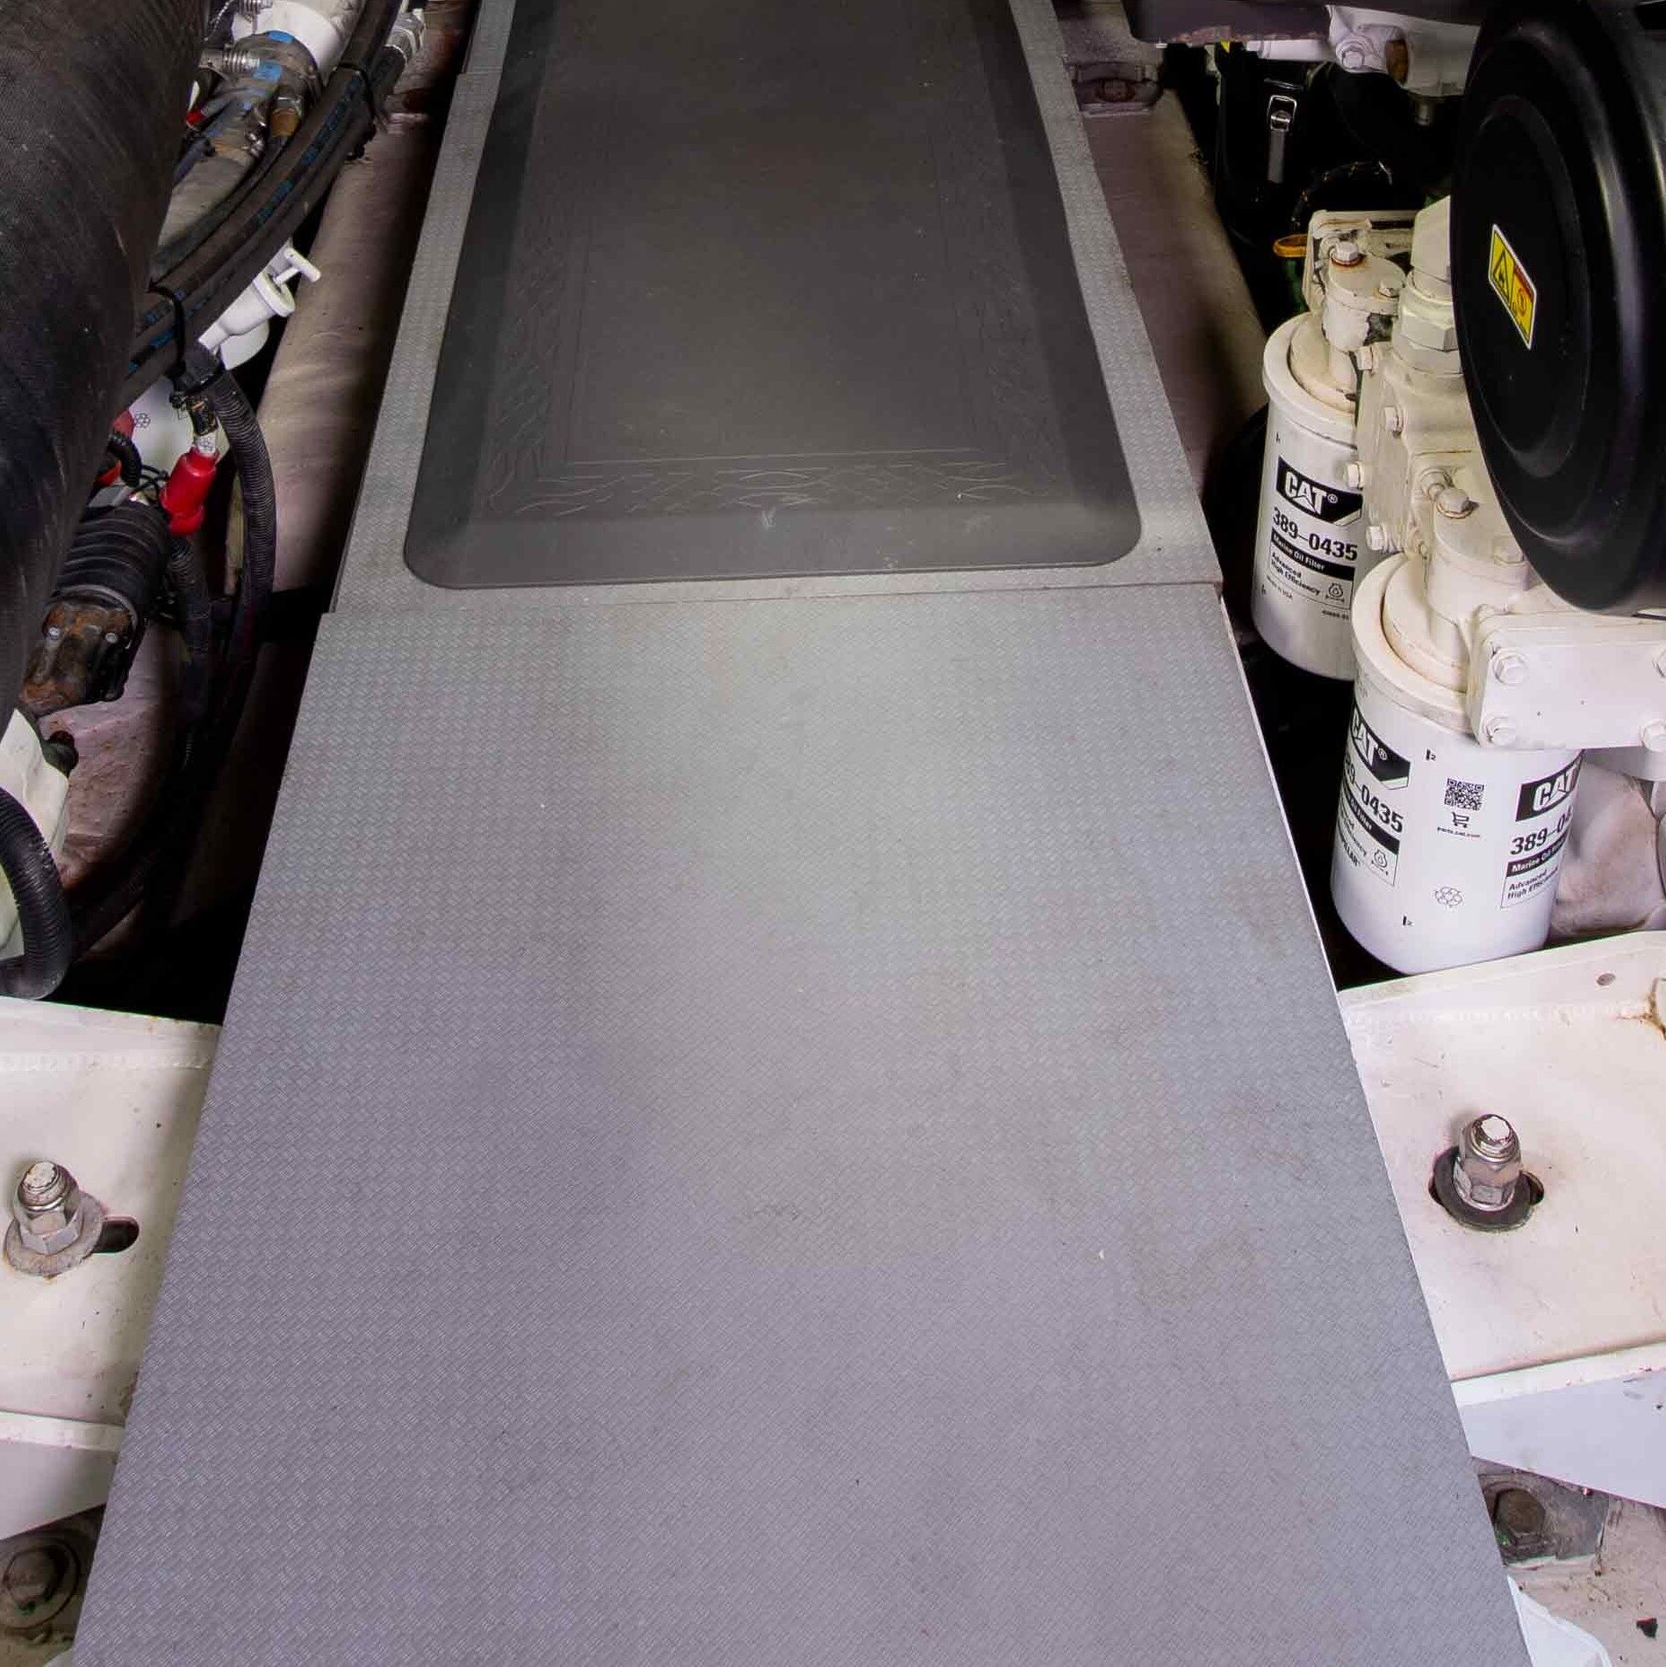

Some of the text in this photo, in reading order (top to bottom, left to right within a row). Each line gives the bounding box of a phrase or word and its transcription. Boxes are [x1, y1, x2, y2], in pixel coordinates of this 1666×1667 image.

[1272, 506, 1359, 562] 389-0435
[1273, 533, 1326, 571] Marine Oil Filter
[1272, 551, 1302, 578] Advanced
[1284, 572, 1321, 596] Efficiency
[1511, 858, 1540, 873] Marine
[1508, 869, 1548, 891] Advanced
[1507, 888, 1527, 900] High
